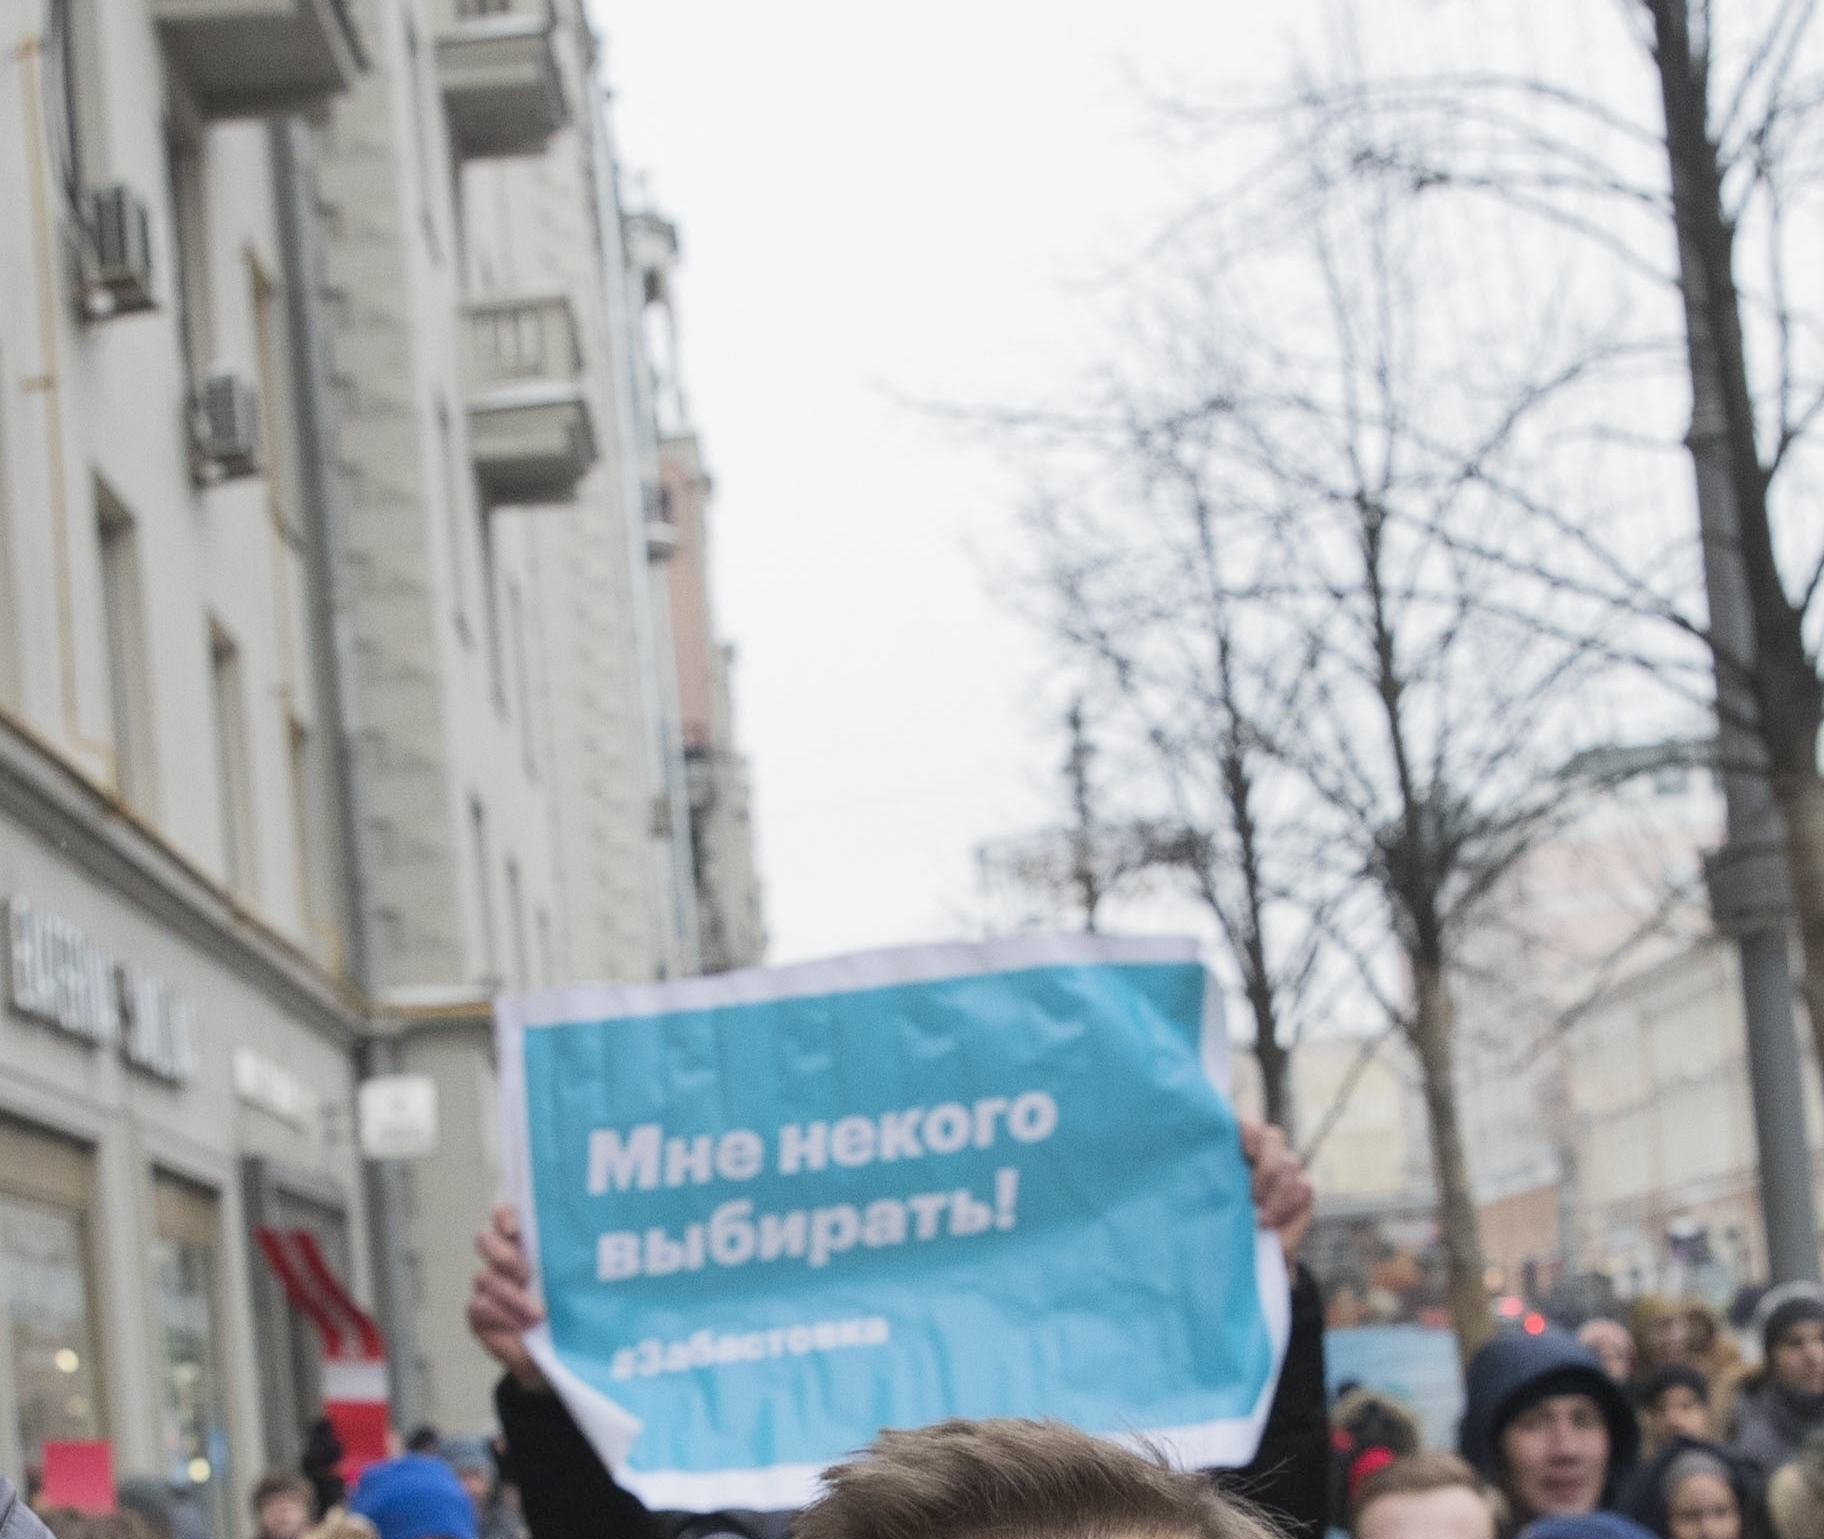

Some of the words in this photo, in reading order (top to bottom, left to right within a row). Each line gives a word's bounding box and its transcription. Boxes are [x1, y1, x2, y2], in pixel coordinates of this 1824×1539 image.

[587, 1122, 766, 1195] Мне
[778, 1090, 1059, 1175] некого
[596, 1166, 1021, 1282] выбирать!
